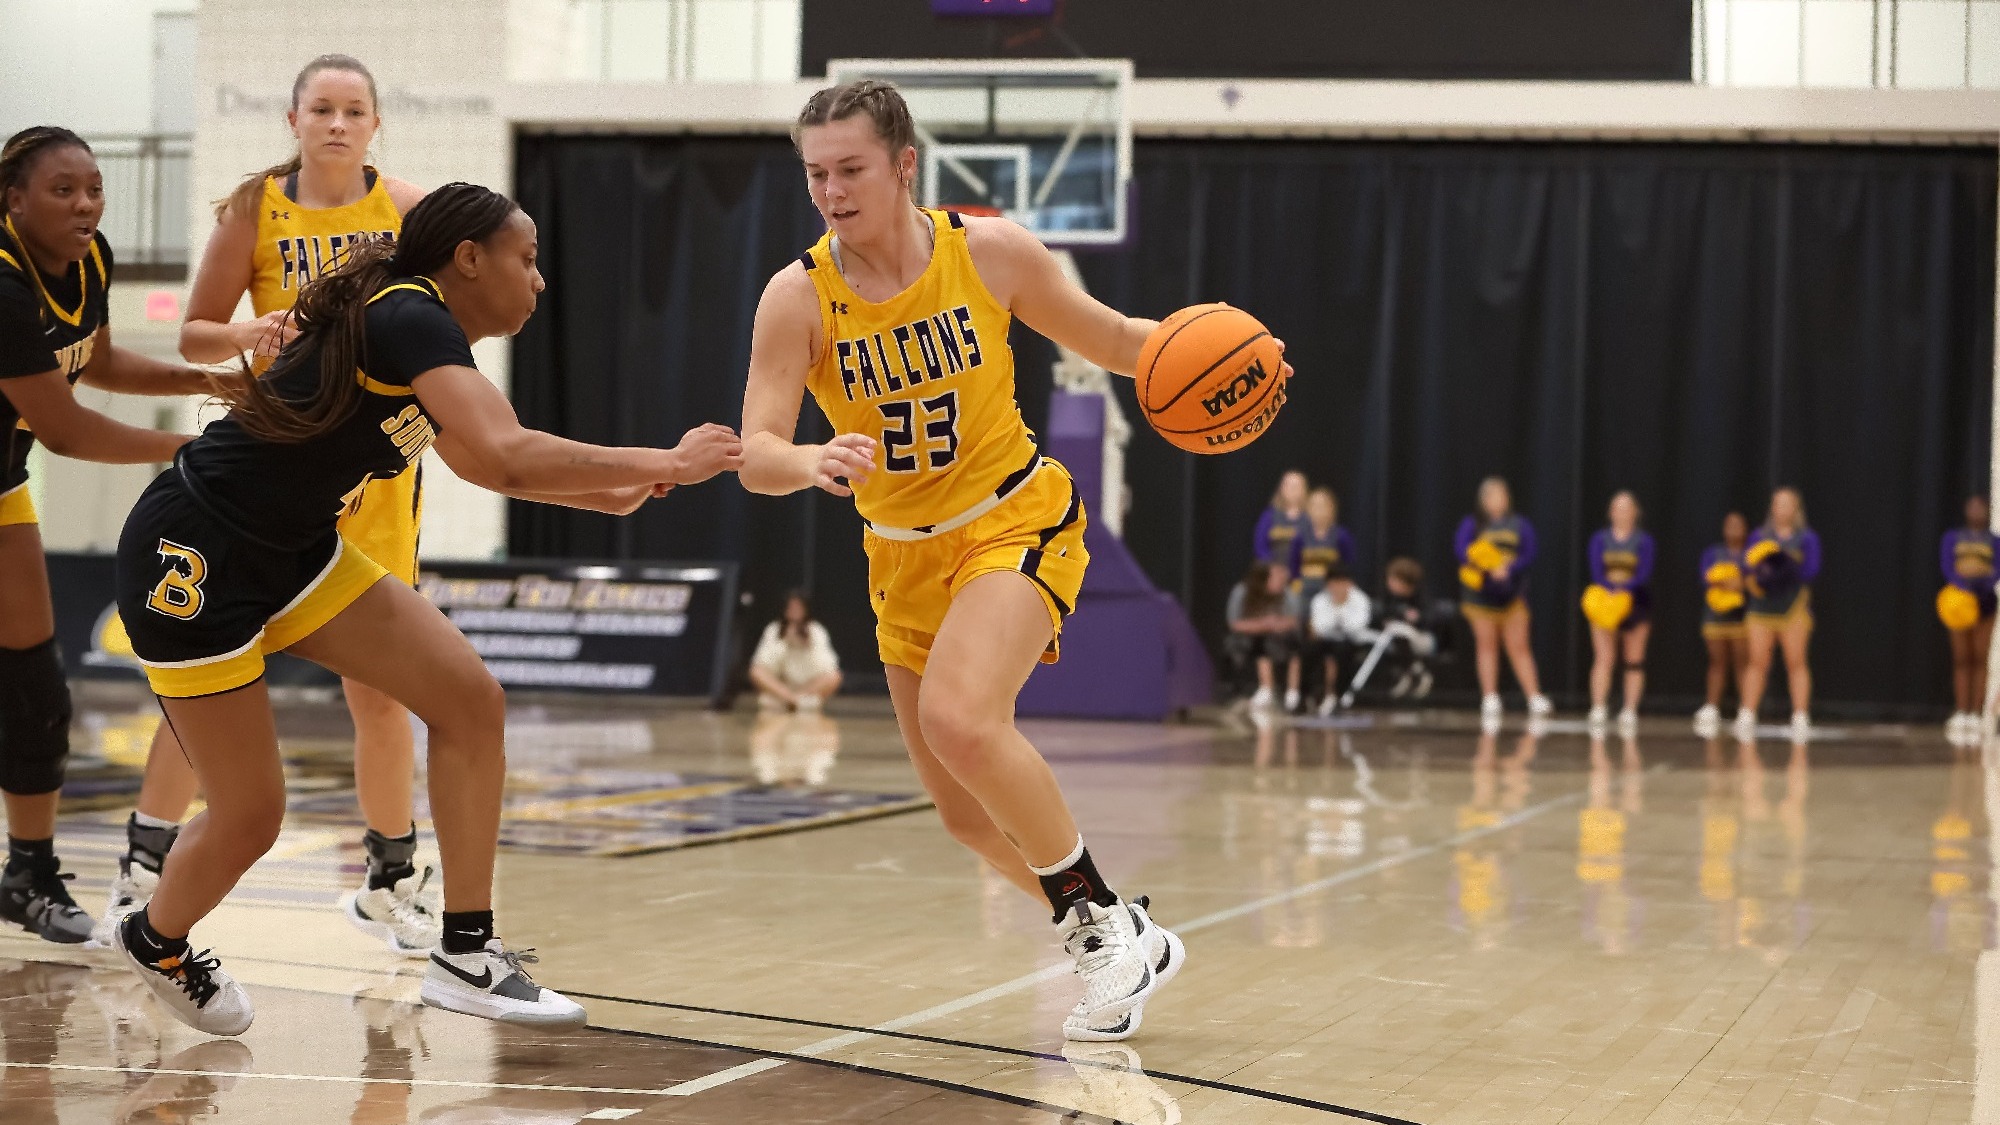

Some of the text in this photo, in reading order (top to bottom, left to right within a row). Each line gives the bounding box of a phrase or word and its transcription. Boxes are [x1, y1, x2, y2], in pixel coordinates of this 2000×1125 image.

[835, 304, 984, 402] FALCONS
[1201, 358, 1267, 412] NCAA
[875, 388, 962, 474] 23
[145, 537, 208, 621] B
